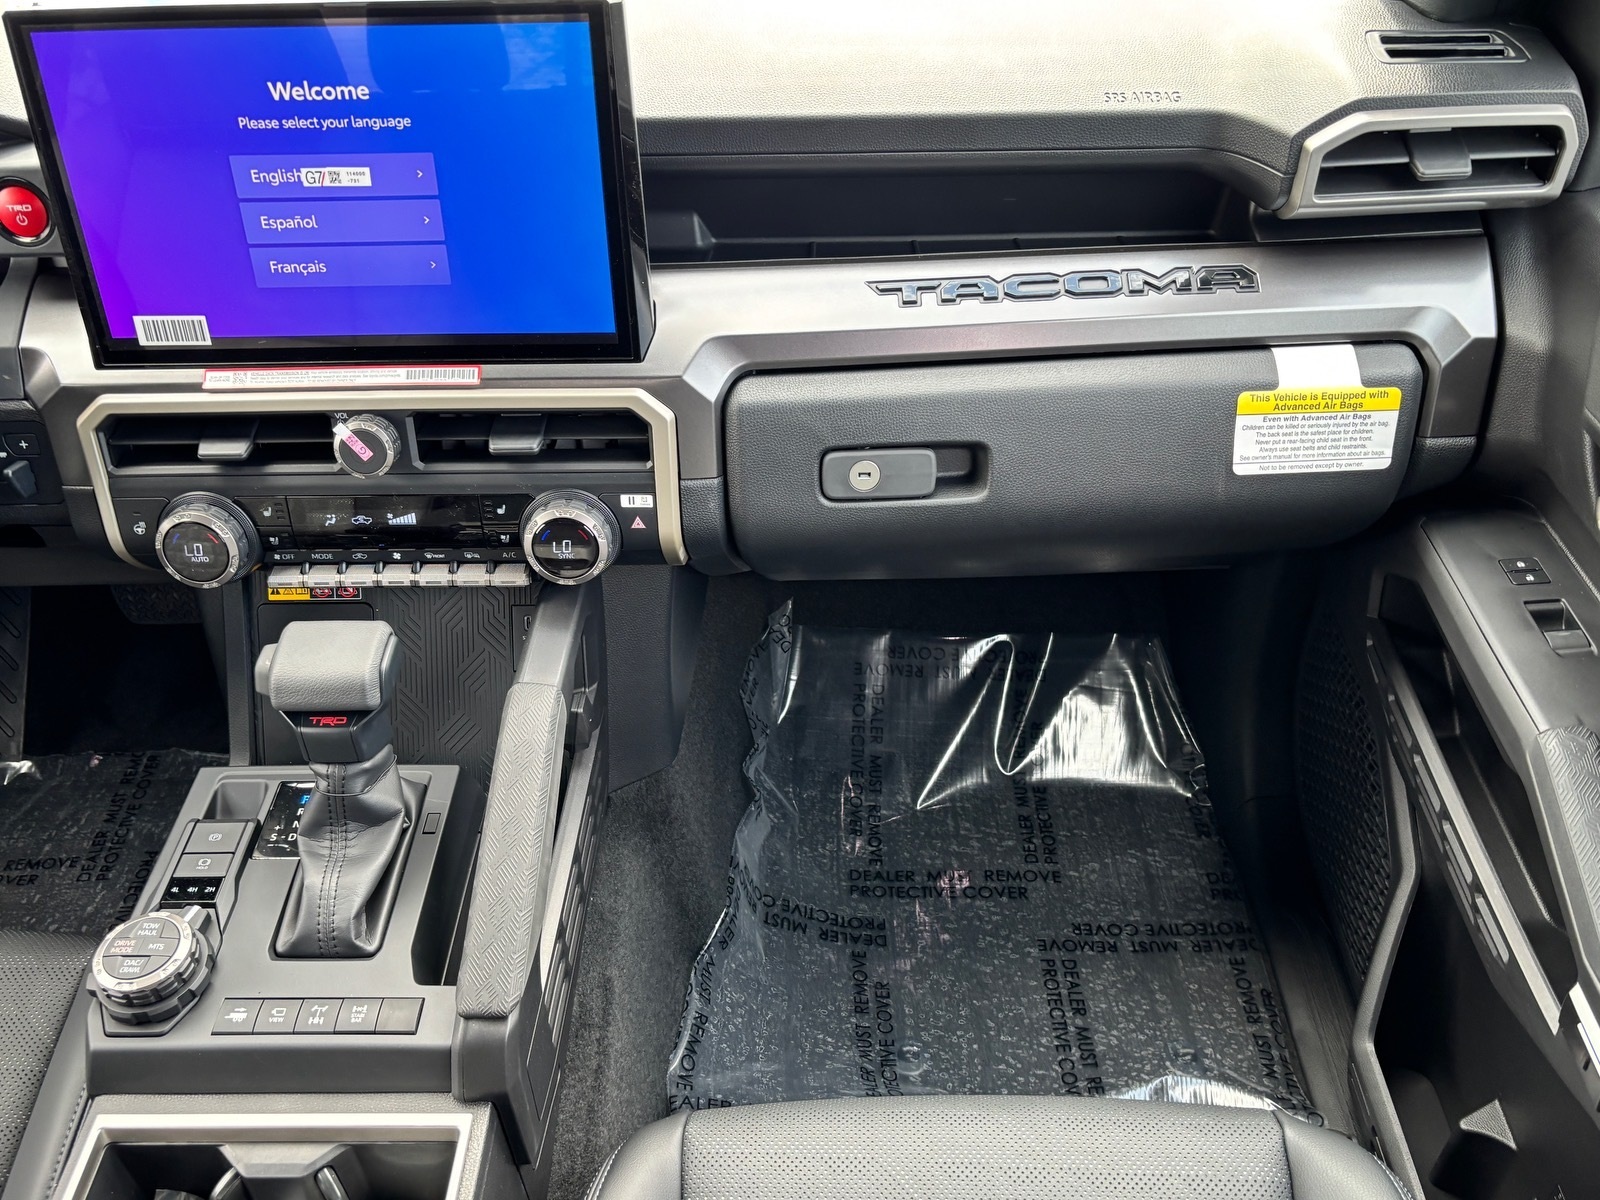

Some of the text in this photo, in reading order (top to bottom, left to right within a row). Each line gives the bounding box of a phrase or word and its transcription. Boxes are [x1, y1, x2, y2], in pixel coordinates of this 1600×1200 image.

[266, 80, 370, 101] Welcome
[1104, 90, 1181, 103] SRS AIRBAG
[238, 115, 411, 131] Please select your language
[250, 169, 302, 186] English
[5, 204, 32, 212] TRD
[260, 215, 318, 231] Español
[269, 260, 327, 276] Français
[865, 264, 1262, 308] TACOMA
[1250, 390, 1389, 402] This Vehicle is Equipped with
[1273, 401, 1364, 411] Advanced Air Bags
[1352, 413, 1372, 421] Bags
[1352, 421, 1359, 429] by
[1259, 446, 1278, 454] Always
[184, 543, 203, 557] LO
[553, 540, 571, 553] LO
[888, 646, 946, 660] COVER
[854, 662, 925, 679] REMOVE
[309, 716, 347, 726] TRD
[850, 683, 866, 837] PROTECTIVE COVER
[867, 684, 885, 866] DEALER MUST REMOVE
[95, 755, 162, 882] PROTECTIVE COVER
[1032, 785, 1059, 865] PROTECTIVE
[76, 792, 127, 883] DEALER MUST
[1018, 813, 1038, 864] DEALER
[3, 856, 81, 872] REMOVE
[850, 868, 1062, 884] DEALER MUST REMOVE
[850, 886, 1029, 900] PROTECTIVE COVER
[782, 898, 887, 930] PROTECTIVE
[764, 911, 887, 947] DEALER MUST
[1072, 922, 1139, 938] COVER
[1037, 938, 1178, 953] MUST REMOVE
[699, 953, 716, 1005] MUST
[852, 950, 869, 1014] REMOVE
[875, 981, 894, 1034] COVER
[1040, 959, 1072, 1053] PROTECTIVE
[1061, 959, 1087, 1016] DEALER
[1074, 1026, 1099, 1068] MUST
[1229, 956, 1279, 1080] MUST REMOVE
[676, 1011, 709, 1091] REMOVE
[855, 1023, 873, 1062] MUST
